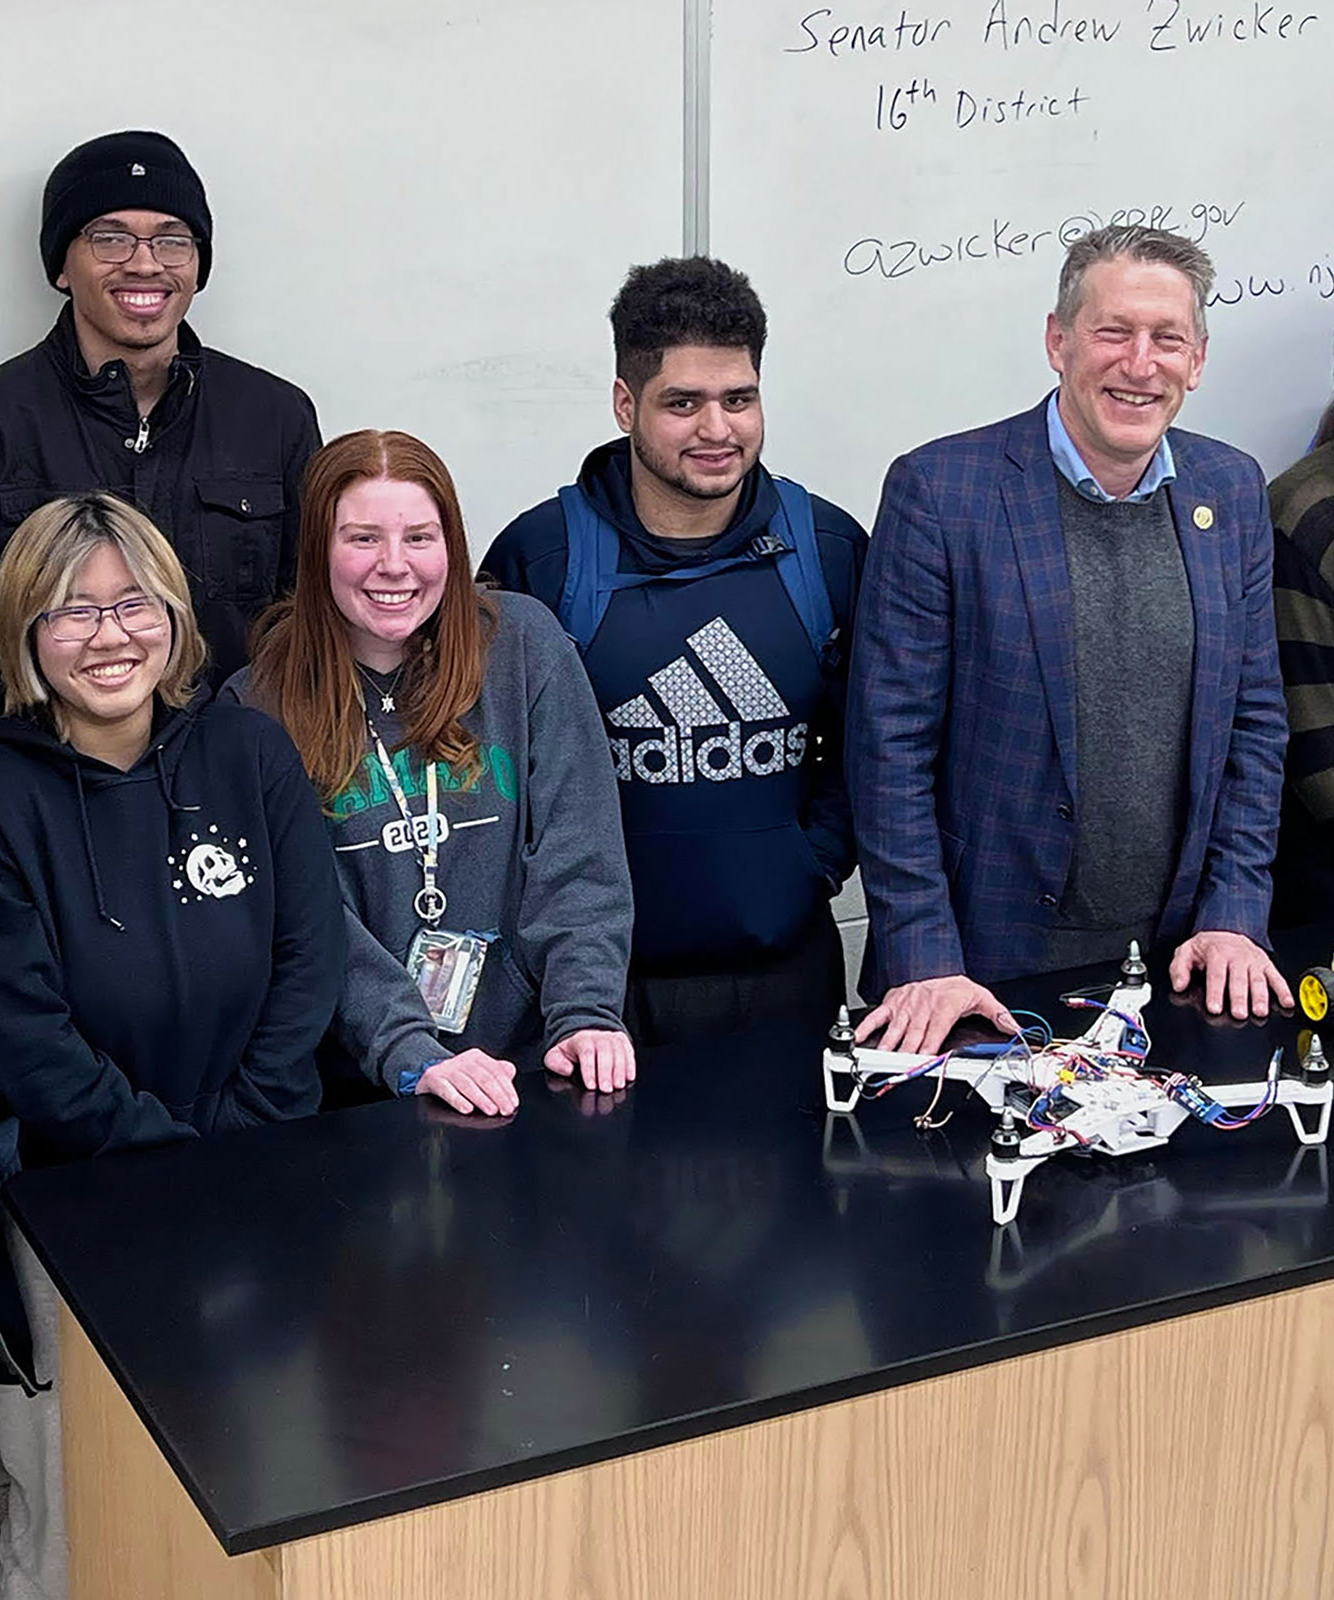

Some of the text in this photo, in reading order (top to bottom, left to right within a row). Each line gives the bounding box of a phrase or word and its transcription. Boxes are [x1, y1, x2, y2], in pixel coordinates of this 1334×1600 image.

[783, 0, 1318, 57] Senator Andrew Zwicker
[876, 77, 1092, 130] 16th District
